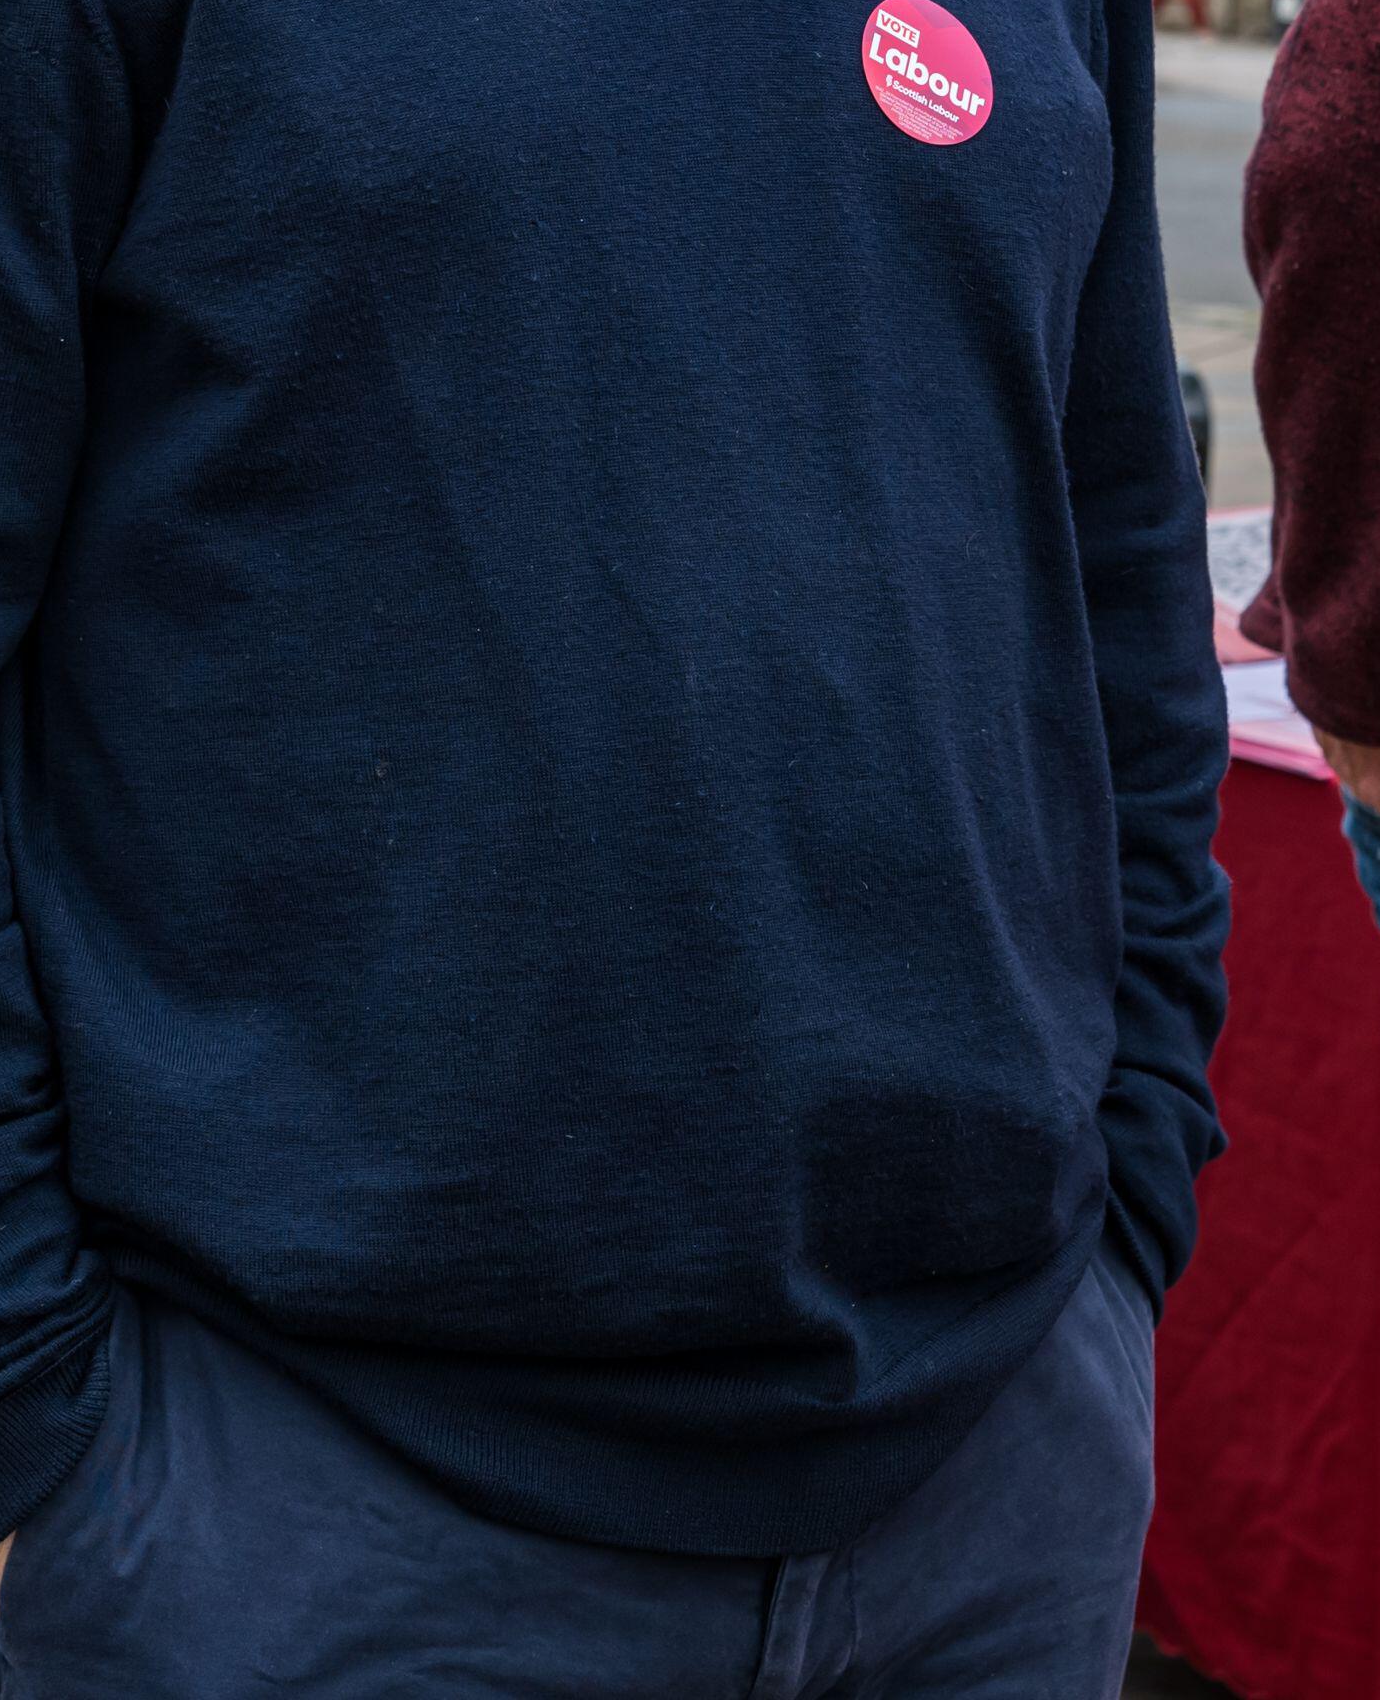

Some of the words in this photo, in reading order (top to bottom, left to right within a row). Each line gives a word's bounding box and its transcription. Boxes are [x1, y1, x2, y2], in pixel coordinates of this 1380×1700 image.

[880, 13, 918, 44] VOTE
[869, 32, 986, 116] Labour
[892, 80, 929, 107] Scottish
[928, 99, 960, 123] Labour
